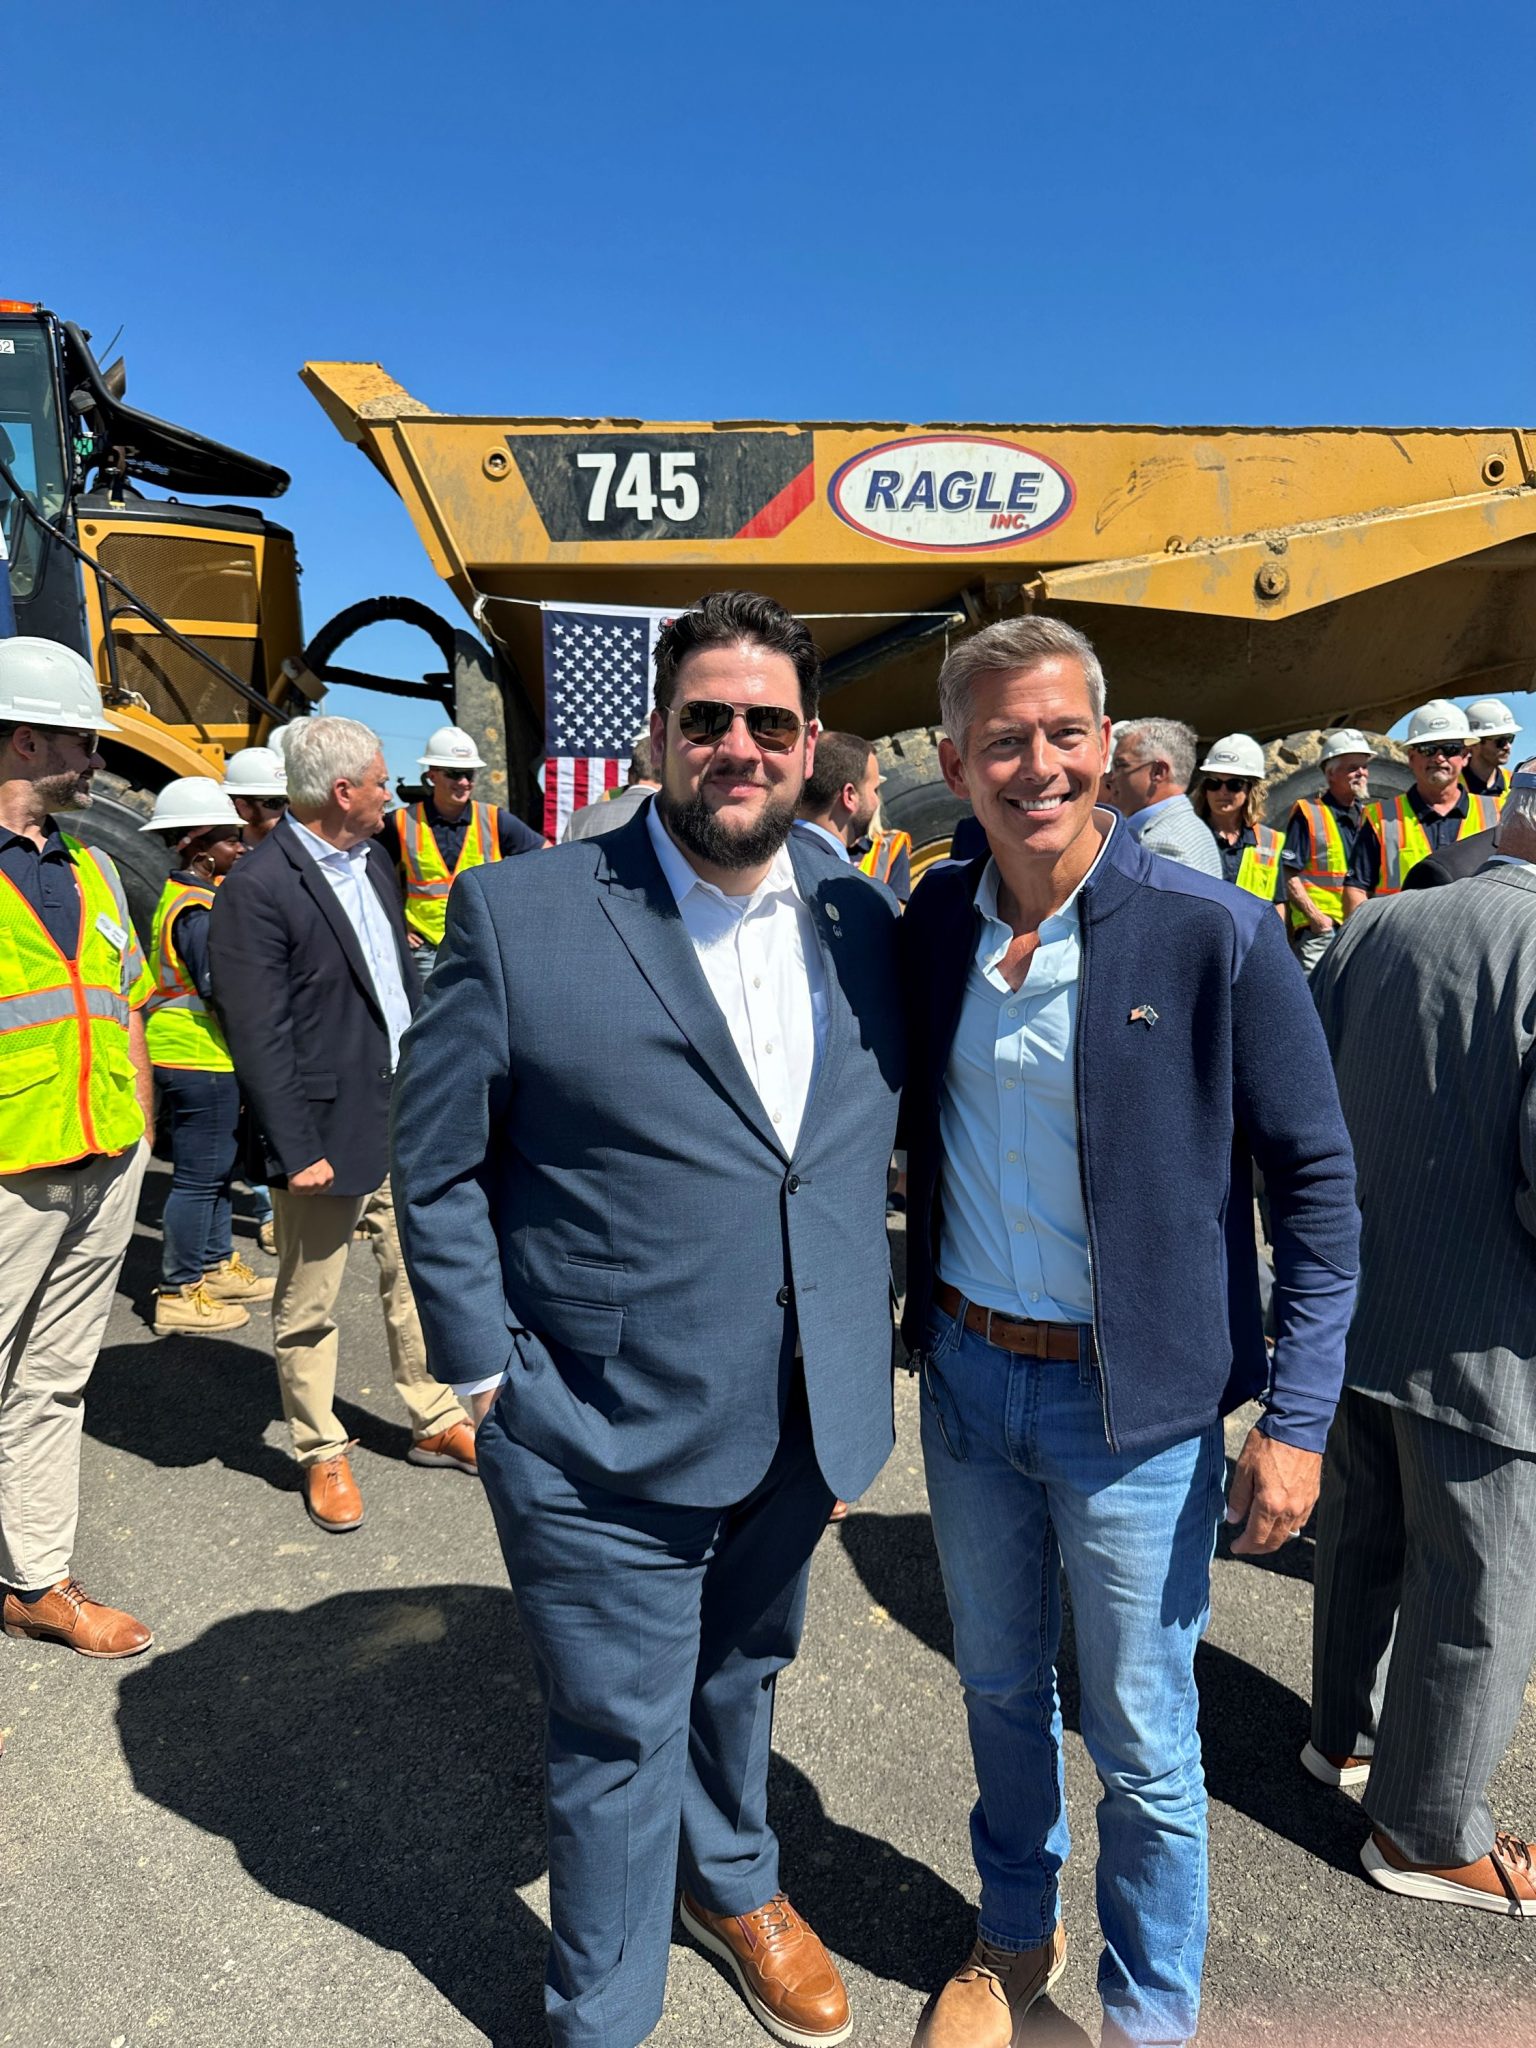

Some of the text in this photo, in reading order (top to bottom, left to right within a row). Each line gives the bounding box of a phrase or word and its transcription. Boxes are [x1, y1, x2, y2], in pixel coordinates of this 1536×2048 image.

[0, 340, 12, 353] 2
[577, 452, 700, 521] 745
[865, 470, 1043, 513] RAGLE
[989, 513, 1030, 529] INC.
